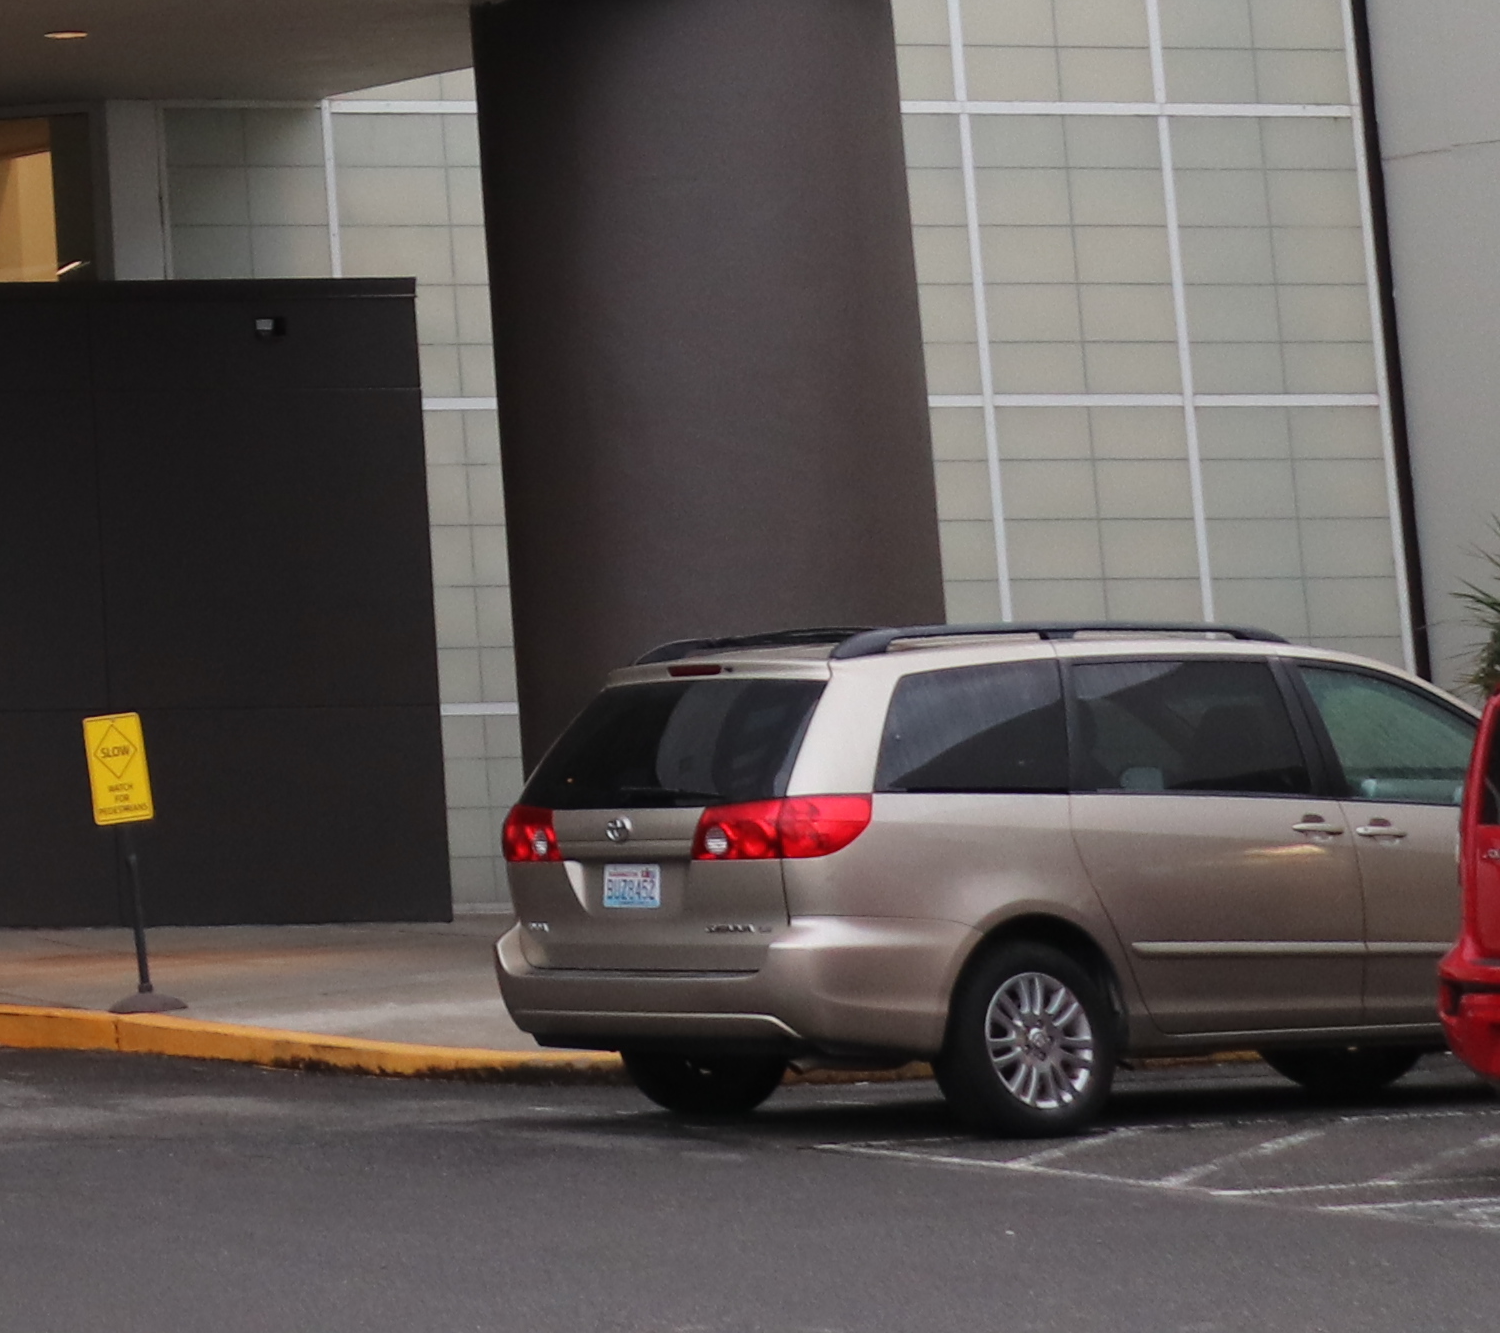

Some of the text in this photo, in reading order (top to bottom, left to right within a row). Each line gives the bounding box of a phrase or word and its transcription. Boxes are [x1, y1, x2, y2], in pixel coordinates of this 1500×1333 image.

[100, 744, 131, 759] SLOW
[108, 783, 134, 793] WATCH
[114, 794, 130, 803] FOR
